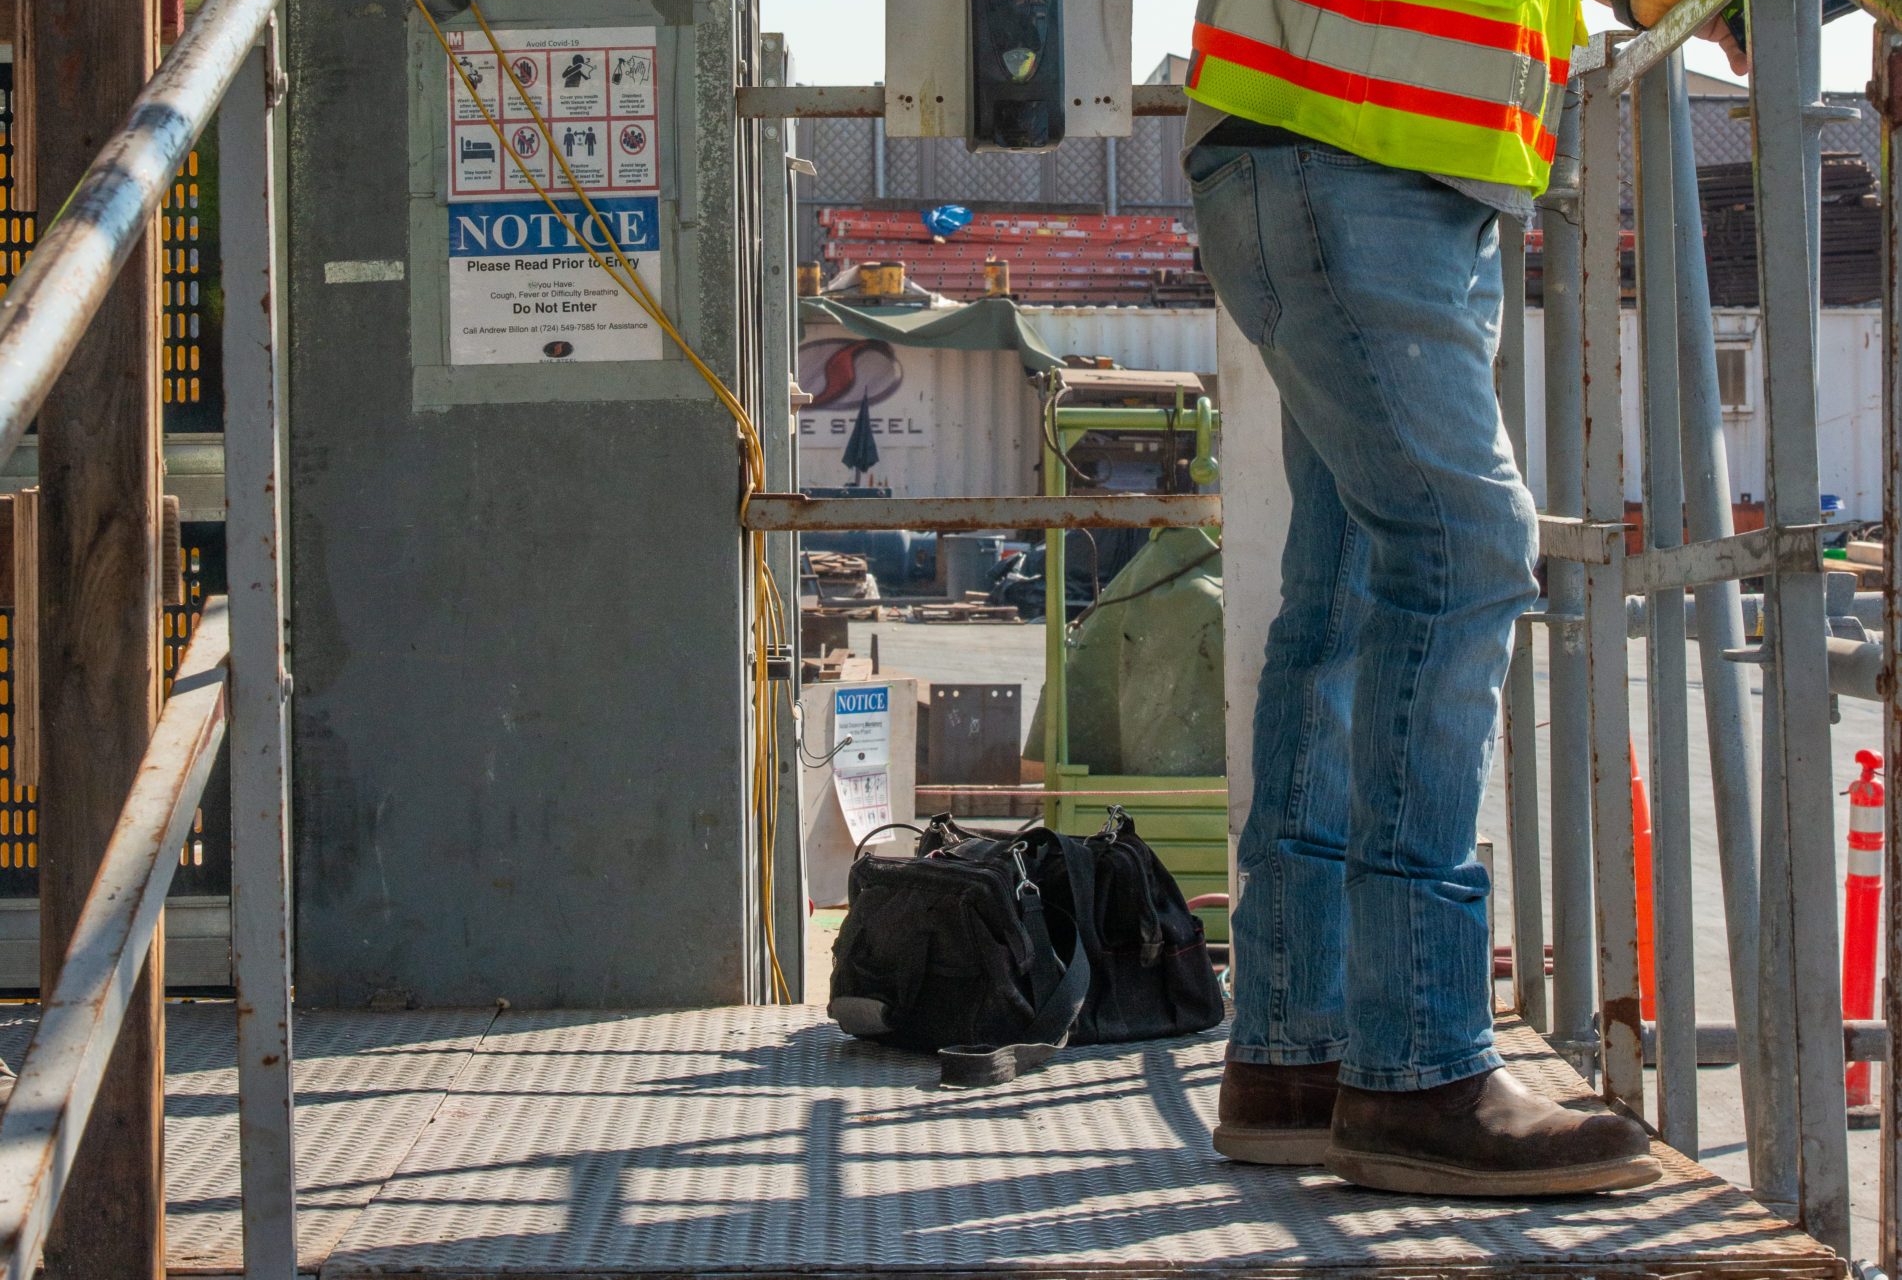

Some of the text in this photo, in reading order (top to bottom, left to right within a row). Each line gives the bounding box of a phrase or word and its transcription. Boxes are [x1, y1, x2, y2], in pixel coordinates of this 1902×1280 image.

[457, 211, 646, 250] NOTICE
[468, 257, 639, 272] Please Read Prior to Enry
[491, 292, 516, 300] Cough,
[551, 290, 581, 298] Difficulty
[584, 289, 618, 297] Breathing
[513, 302, 597, 314] Do Not Enter
[540, 325, 559, 334] (724)
[609, 322, 647, 330] Assistance
[831, 418, 923, 434] SEEL
[839, 693, 885, 712] NOTICE
